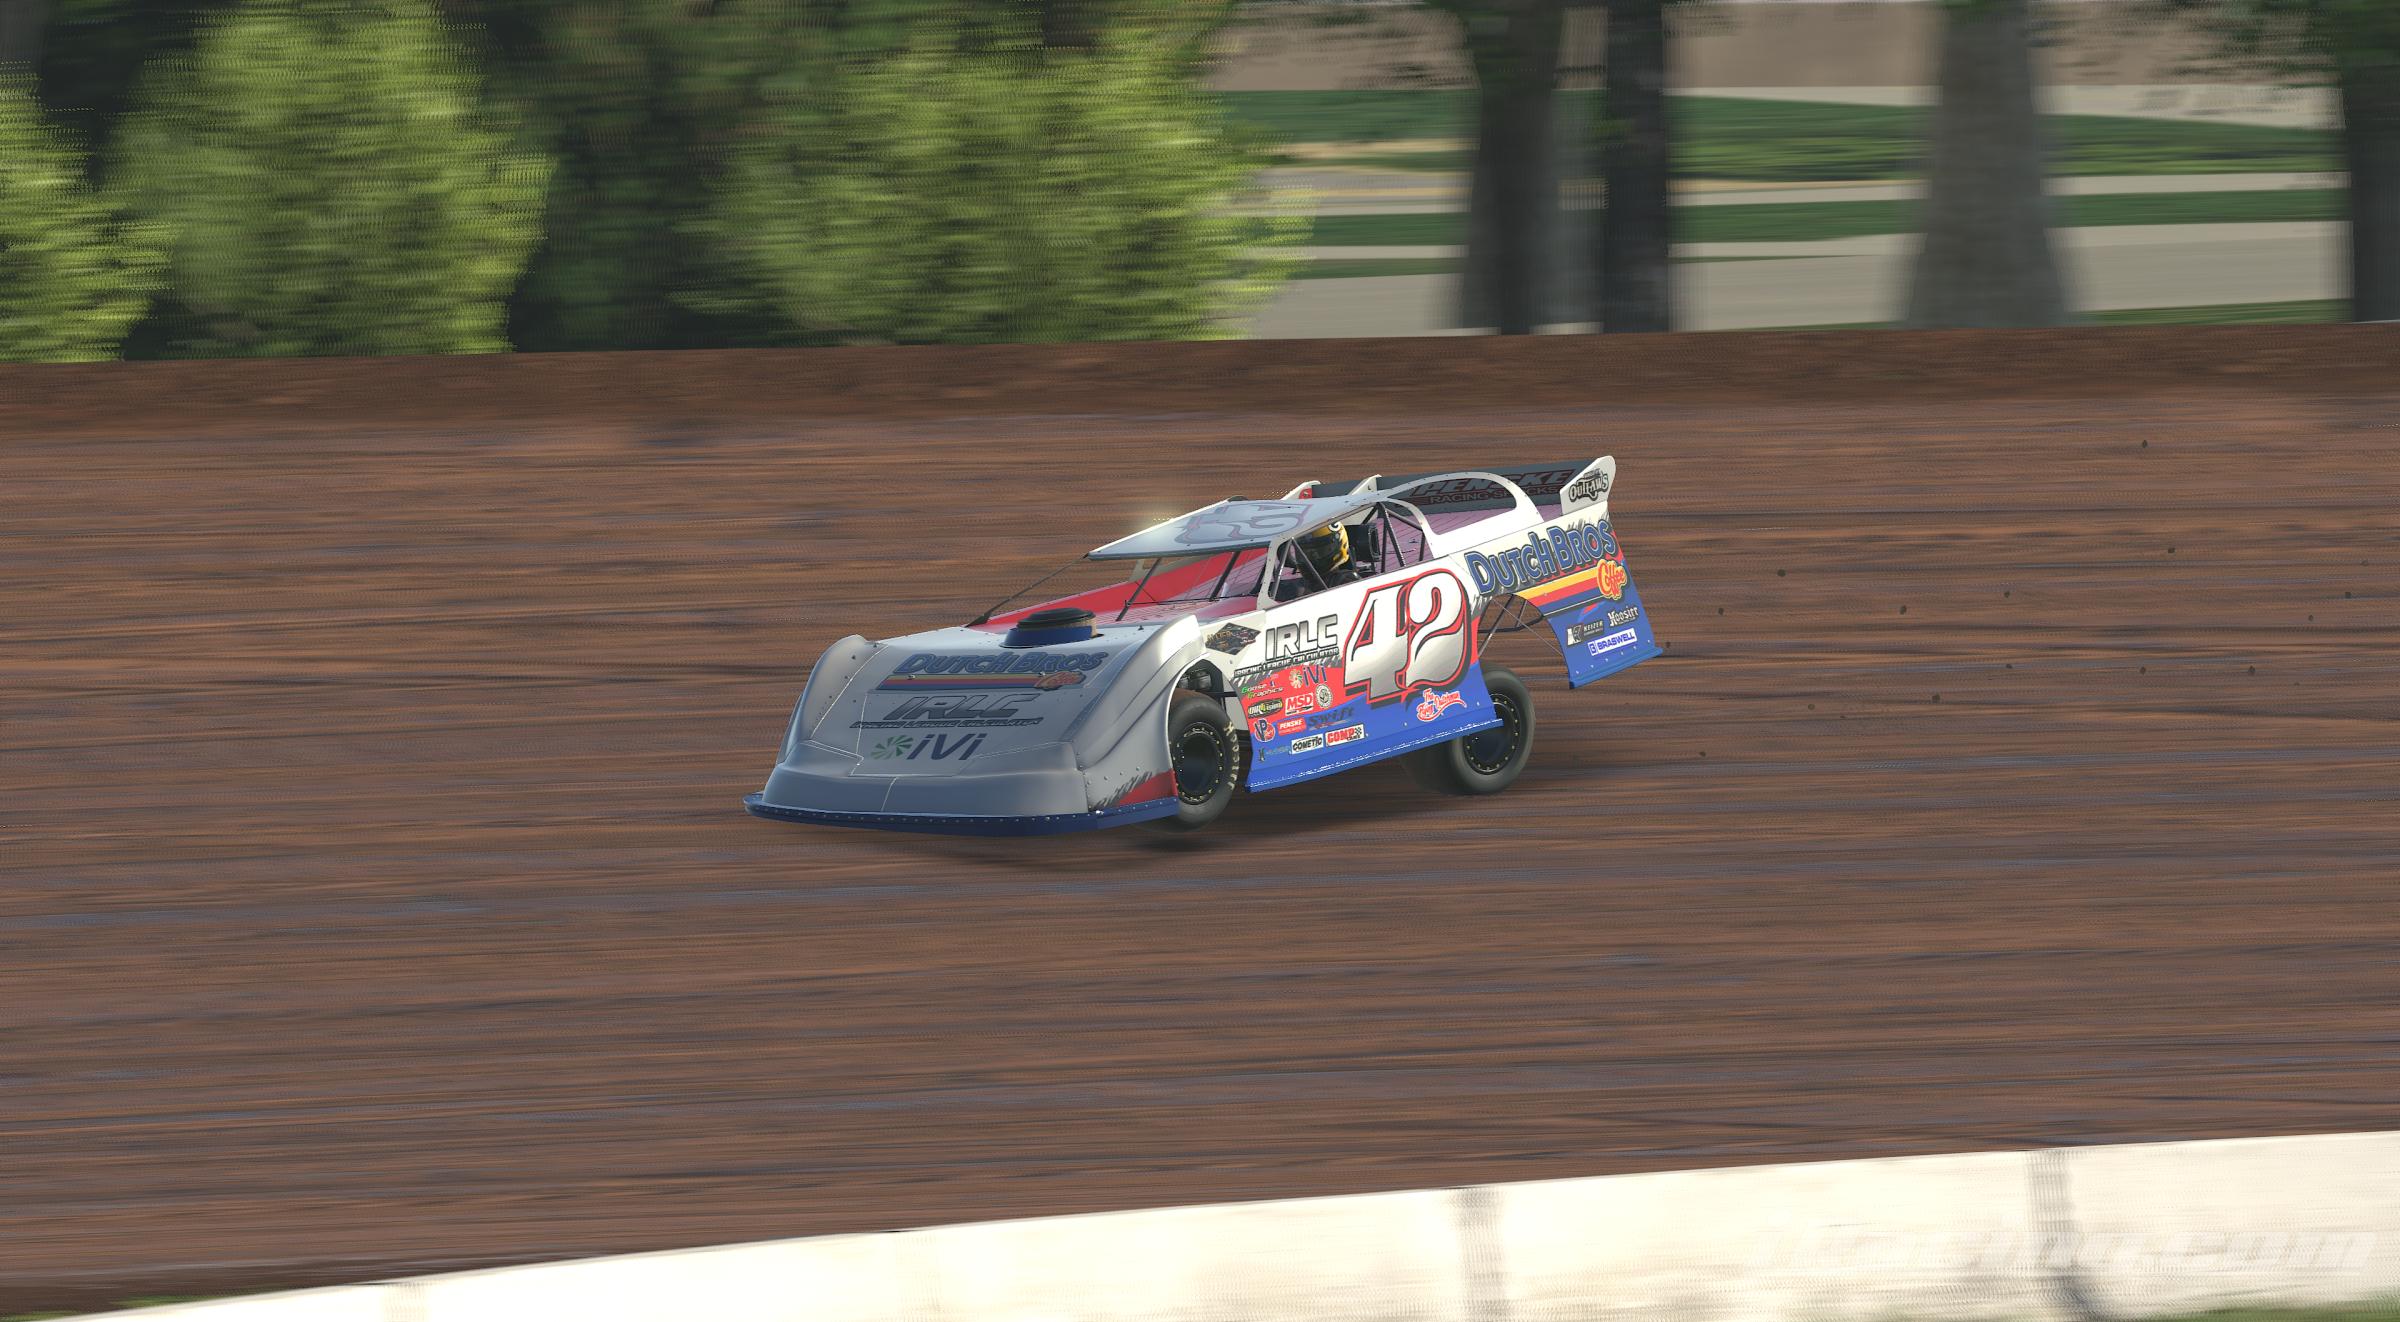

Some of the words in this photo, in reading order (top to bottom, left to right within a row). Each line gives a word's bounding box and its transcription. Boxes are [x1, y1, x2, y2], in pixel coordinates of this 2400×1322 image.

[1430, 491, 1489, 504] RACING
[1492, 486, 1560, 499] SHCKS
[1464, 531, 1559, 596] DUTCH
[1546, 519, 1617, 571] BROS
[1597, 559, 1628, 600] Coffee
[1265, 613, 1338, 661] IRLC
[1344, 568, 1472, 705] 42
[1596, 631, 1635, 651] BRASWELL
[884, 693, 1041, 721] IRLC
[1287, 695, 1312, 711] MSD
